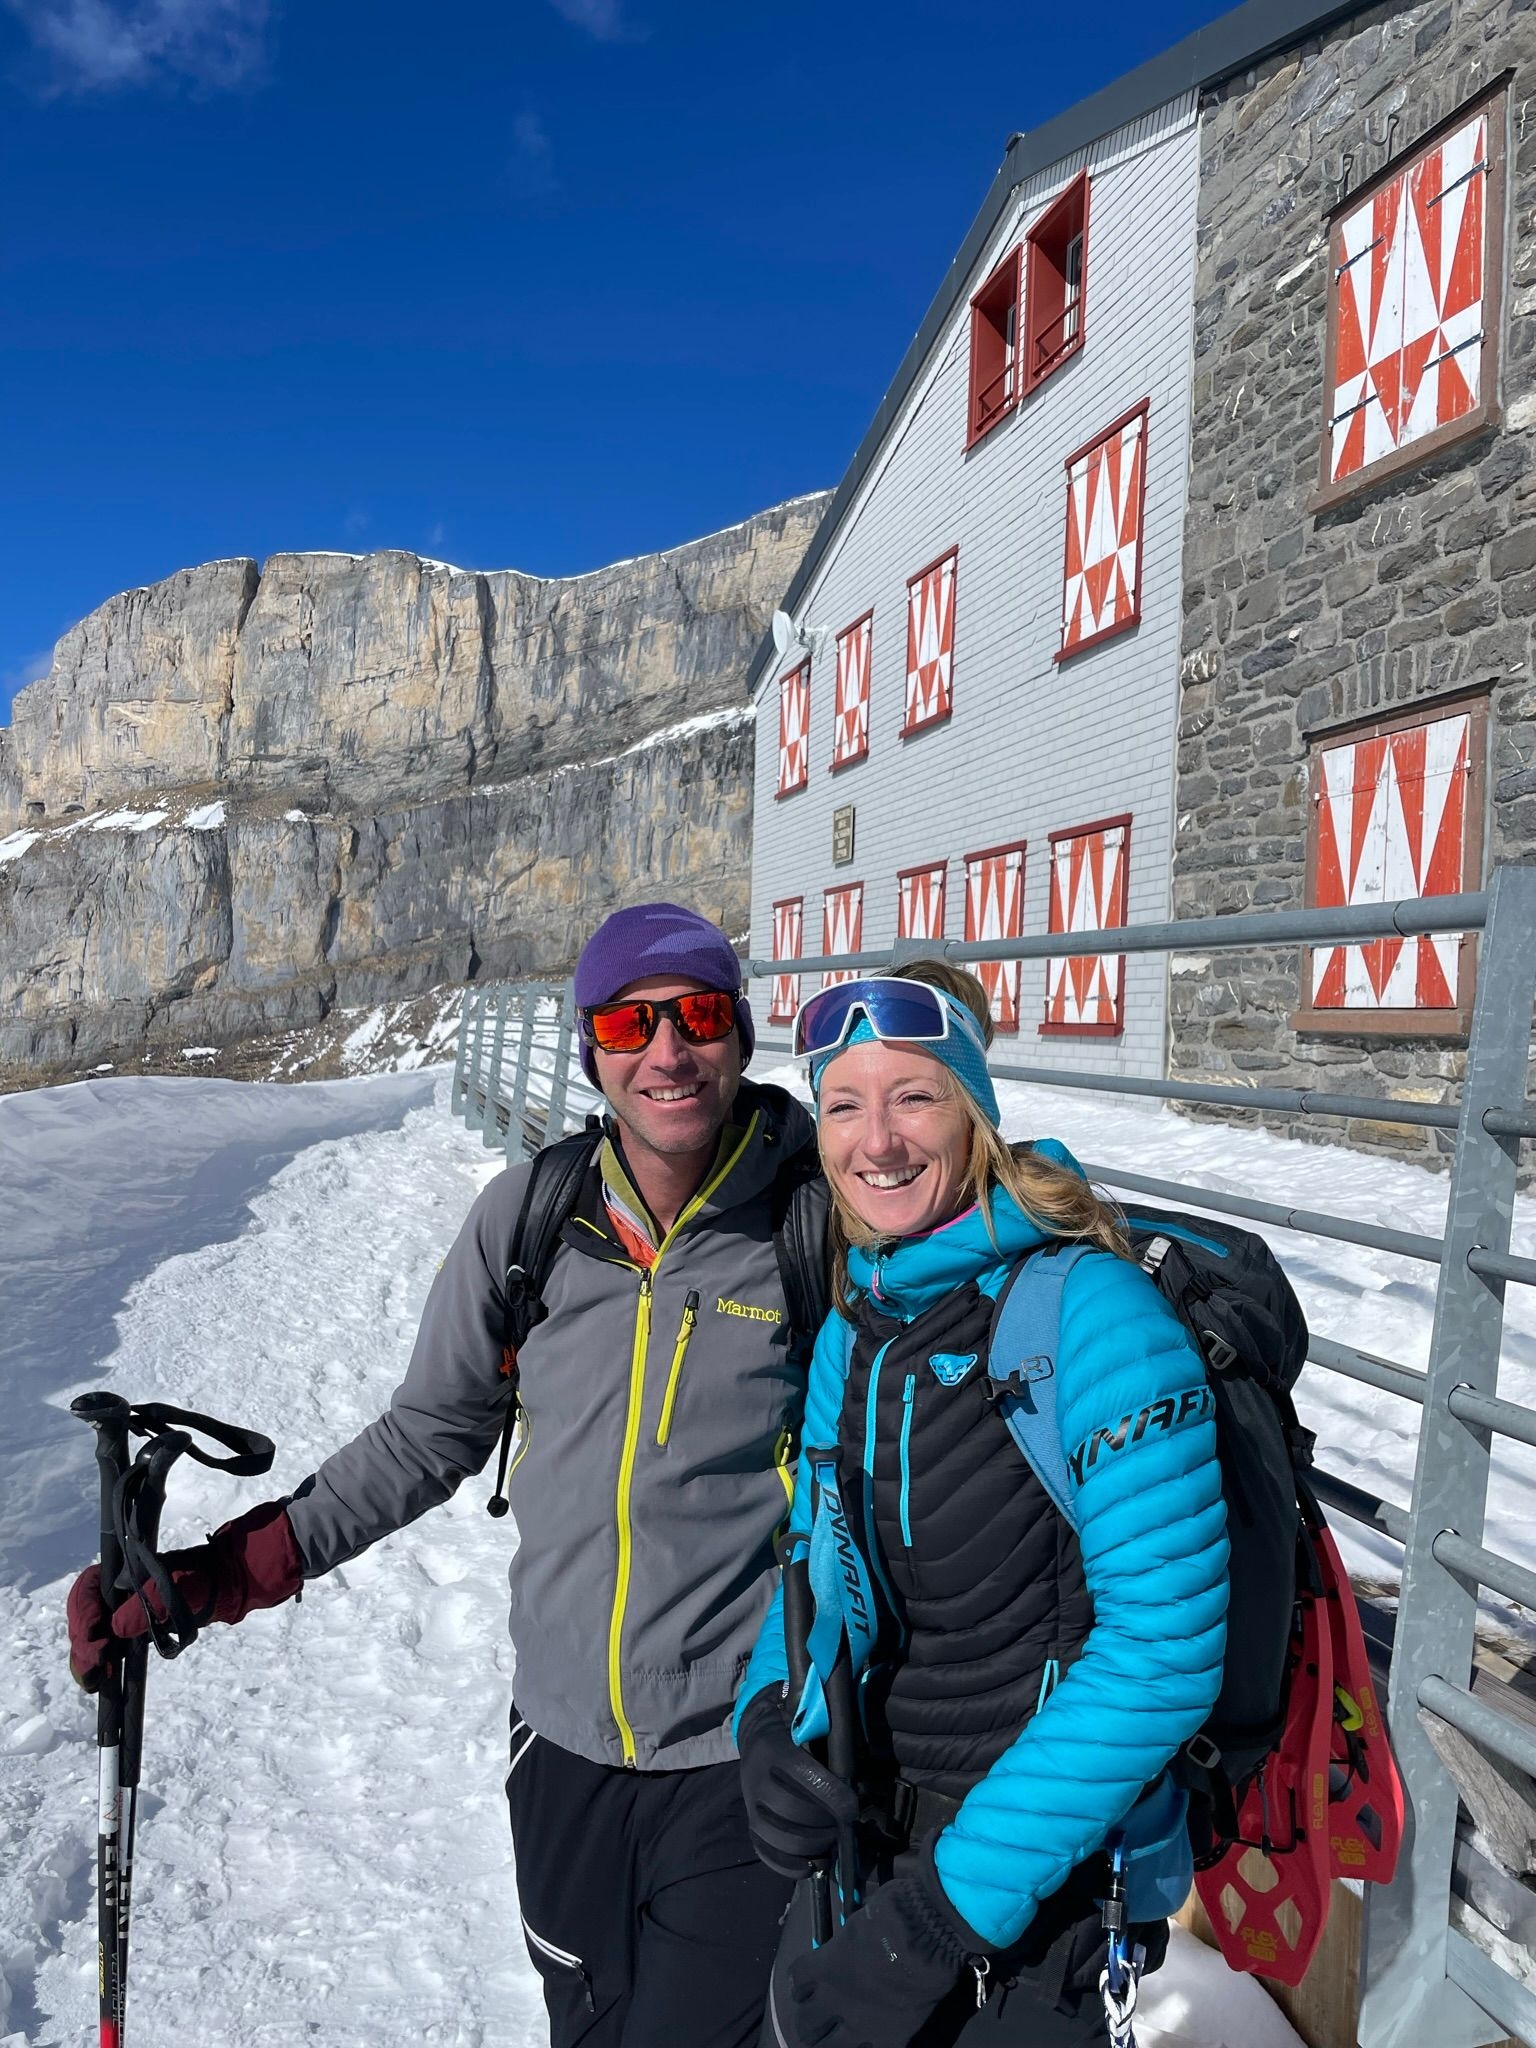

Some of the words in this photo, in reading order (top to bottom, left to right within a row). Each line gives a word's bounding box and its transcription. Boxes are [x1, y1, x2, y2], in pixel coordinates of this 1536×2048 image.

[716, 1297, 781, 1324] Marmot
[1068, 1387, 1214, 1487] YNAFI
[823, 1487, 871, 1640] DYNAFIT
